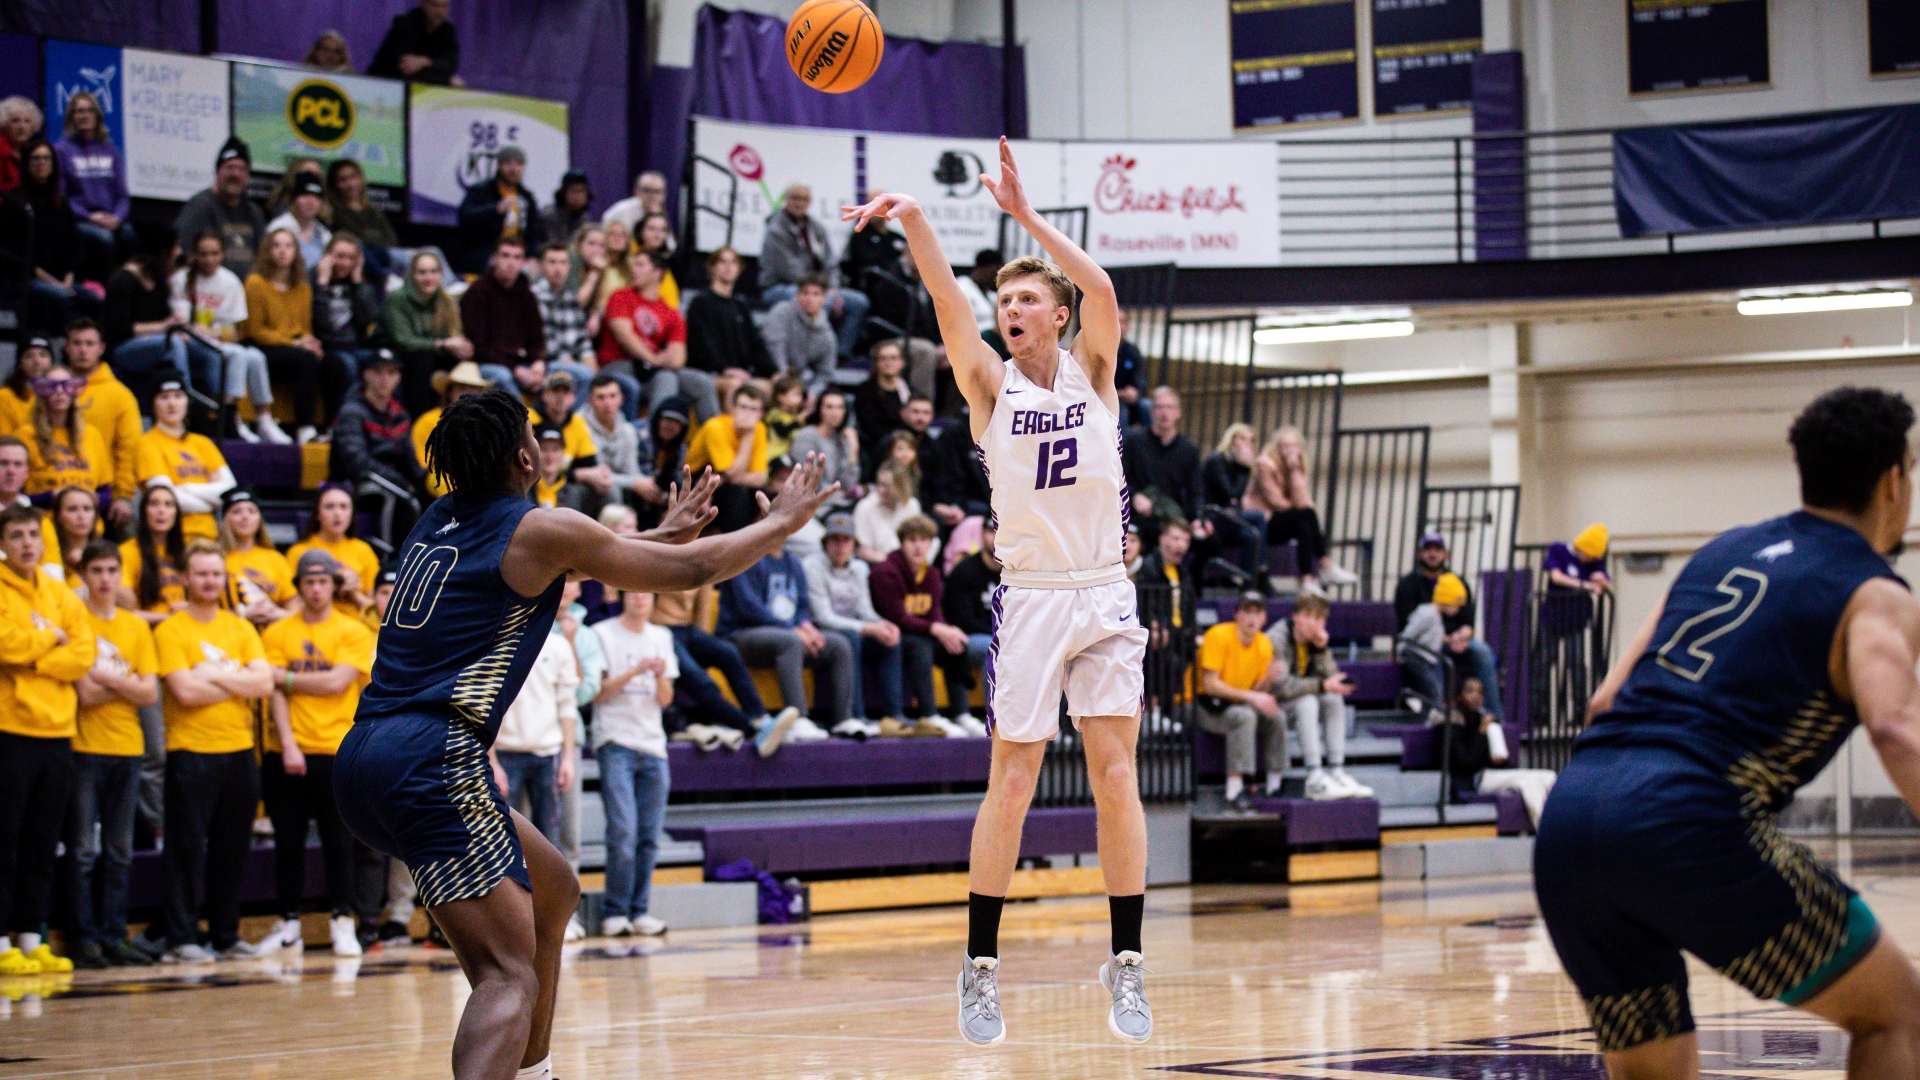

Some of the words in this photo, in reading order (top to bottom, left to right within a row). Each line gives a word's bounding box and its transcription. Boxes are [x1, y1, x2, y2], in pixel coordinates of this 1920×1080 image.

[131, 62, 182, 83] MARY
[805, 31, 850, 82] Wilson
[131, 88, 223, 117] KRUEGER
[296, 94, 346, 129] PCL
[131, 112, 204, 142] TRAVEL
[1099, 233, 1186, 250] Roseville
[1191, 232, 1239, 251] (MN)
[1011, 402, 1087, 435] EAGLES
[1035, 437, 1079, 490] 12
[381, 542, 458, 629] 10
[1656, 567, 1770, 683] 2
